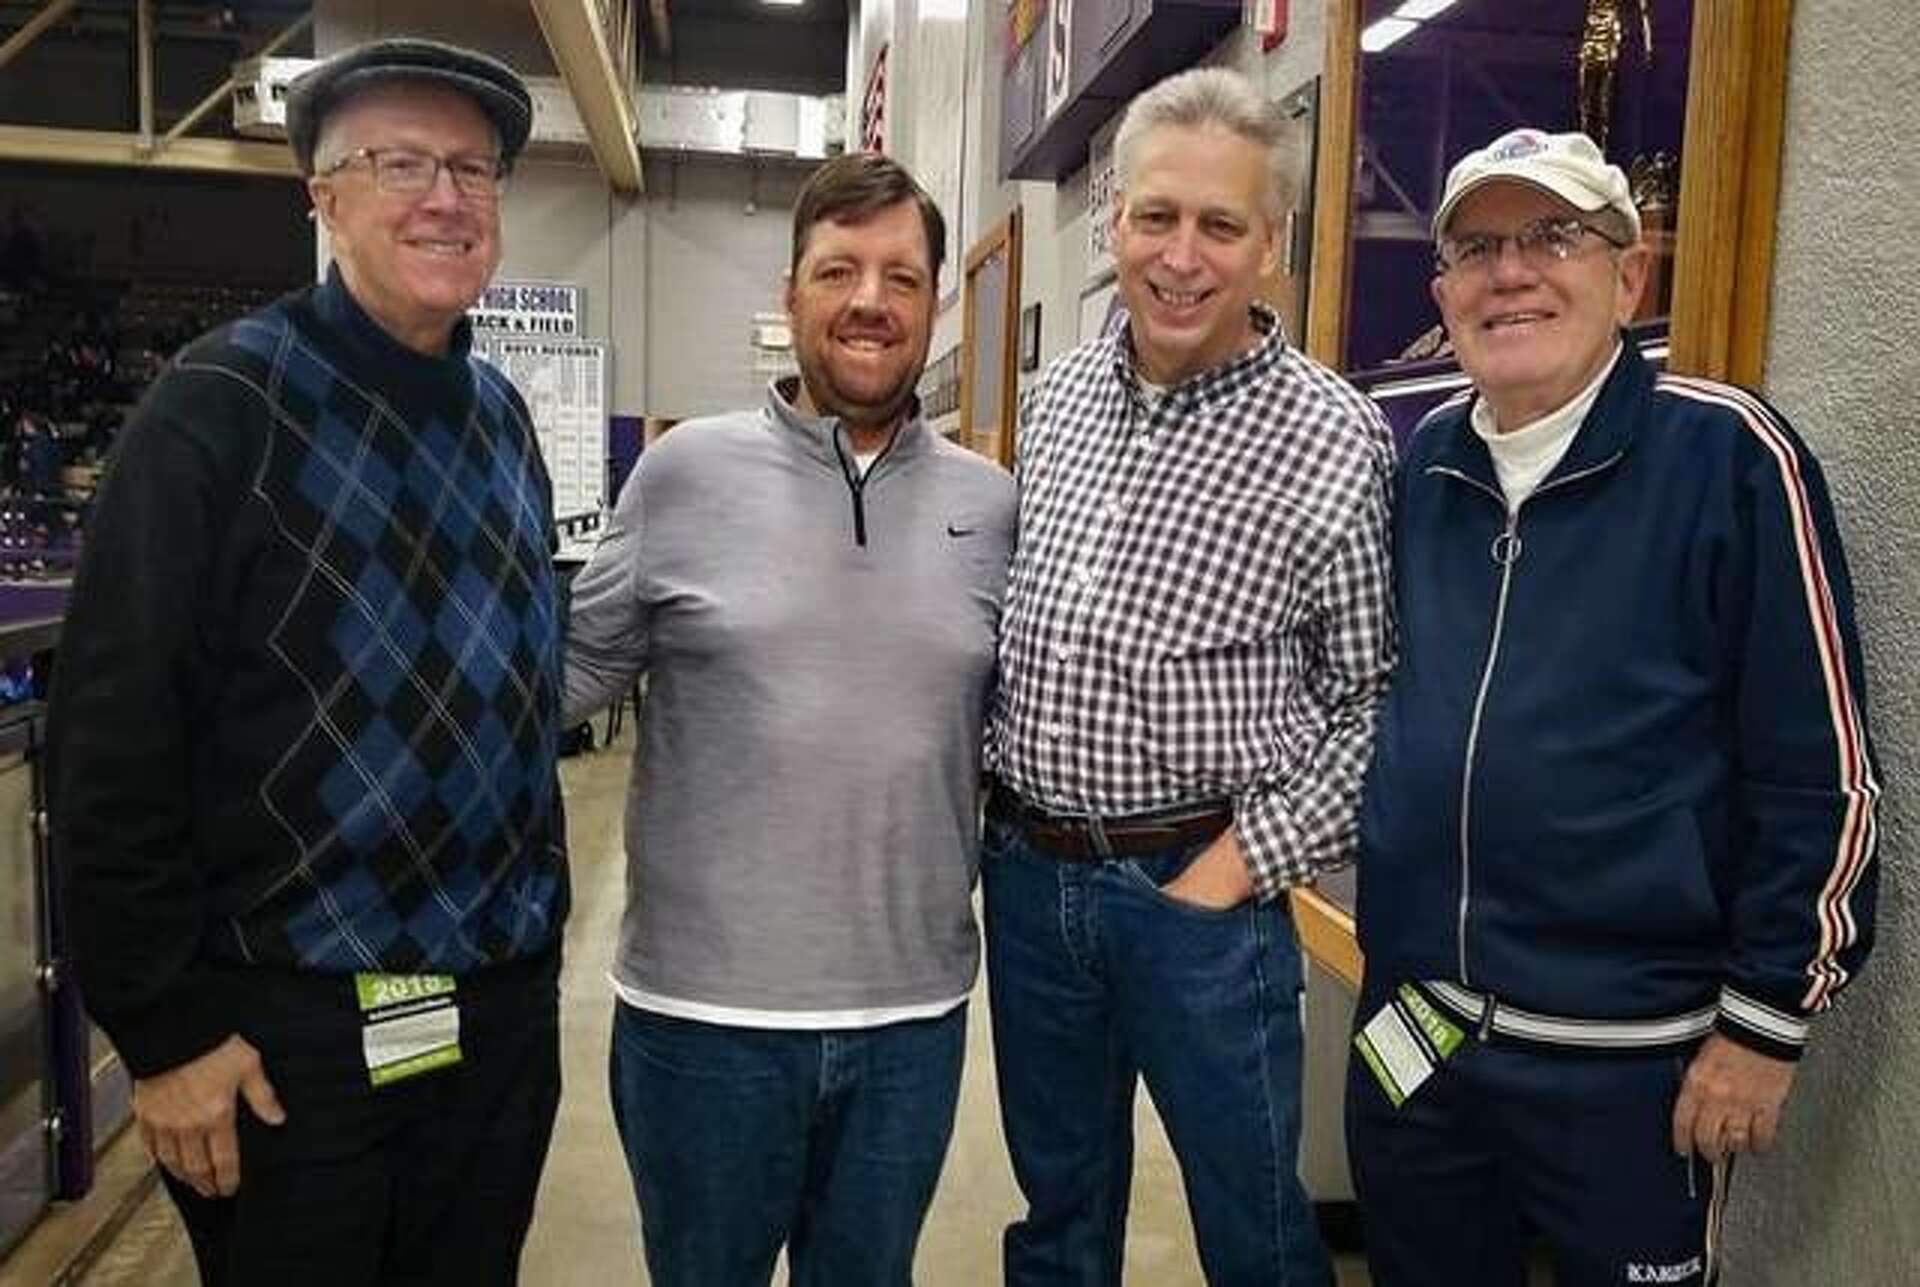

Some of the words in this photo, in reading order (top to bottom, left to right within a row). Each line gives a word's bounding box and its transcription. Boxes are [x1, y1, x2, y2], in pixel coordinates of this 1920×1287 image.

[519, 287, 574, 313] SCHOOL
[475, 314, 510, 331] ACK
[529, 316, 574, 334] FIELD
